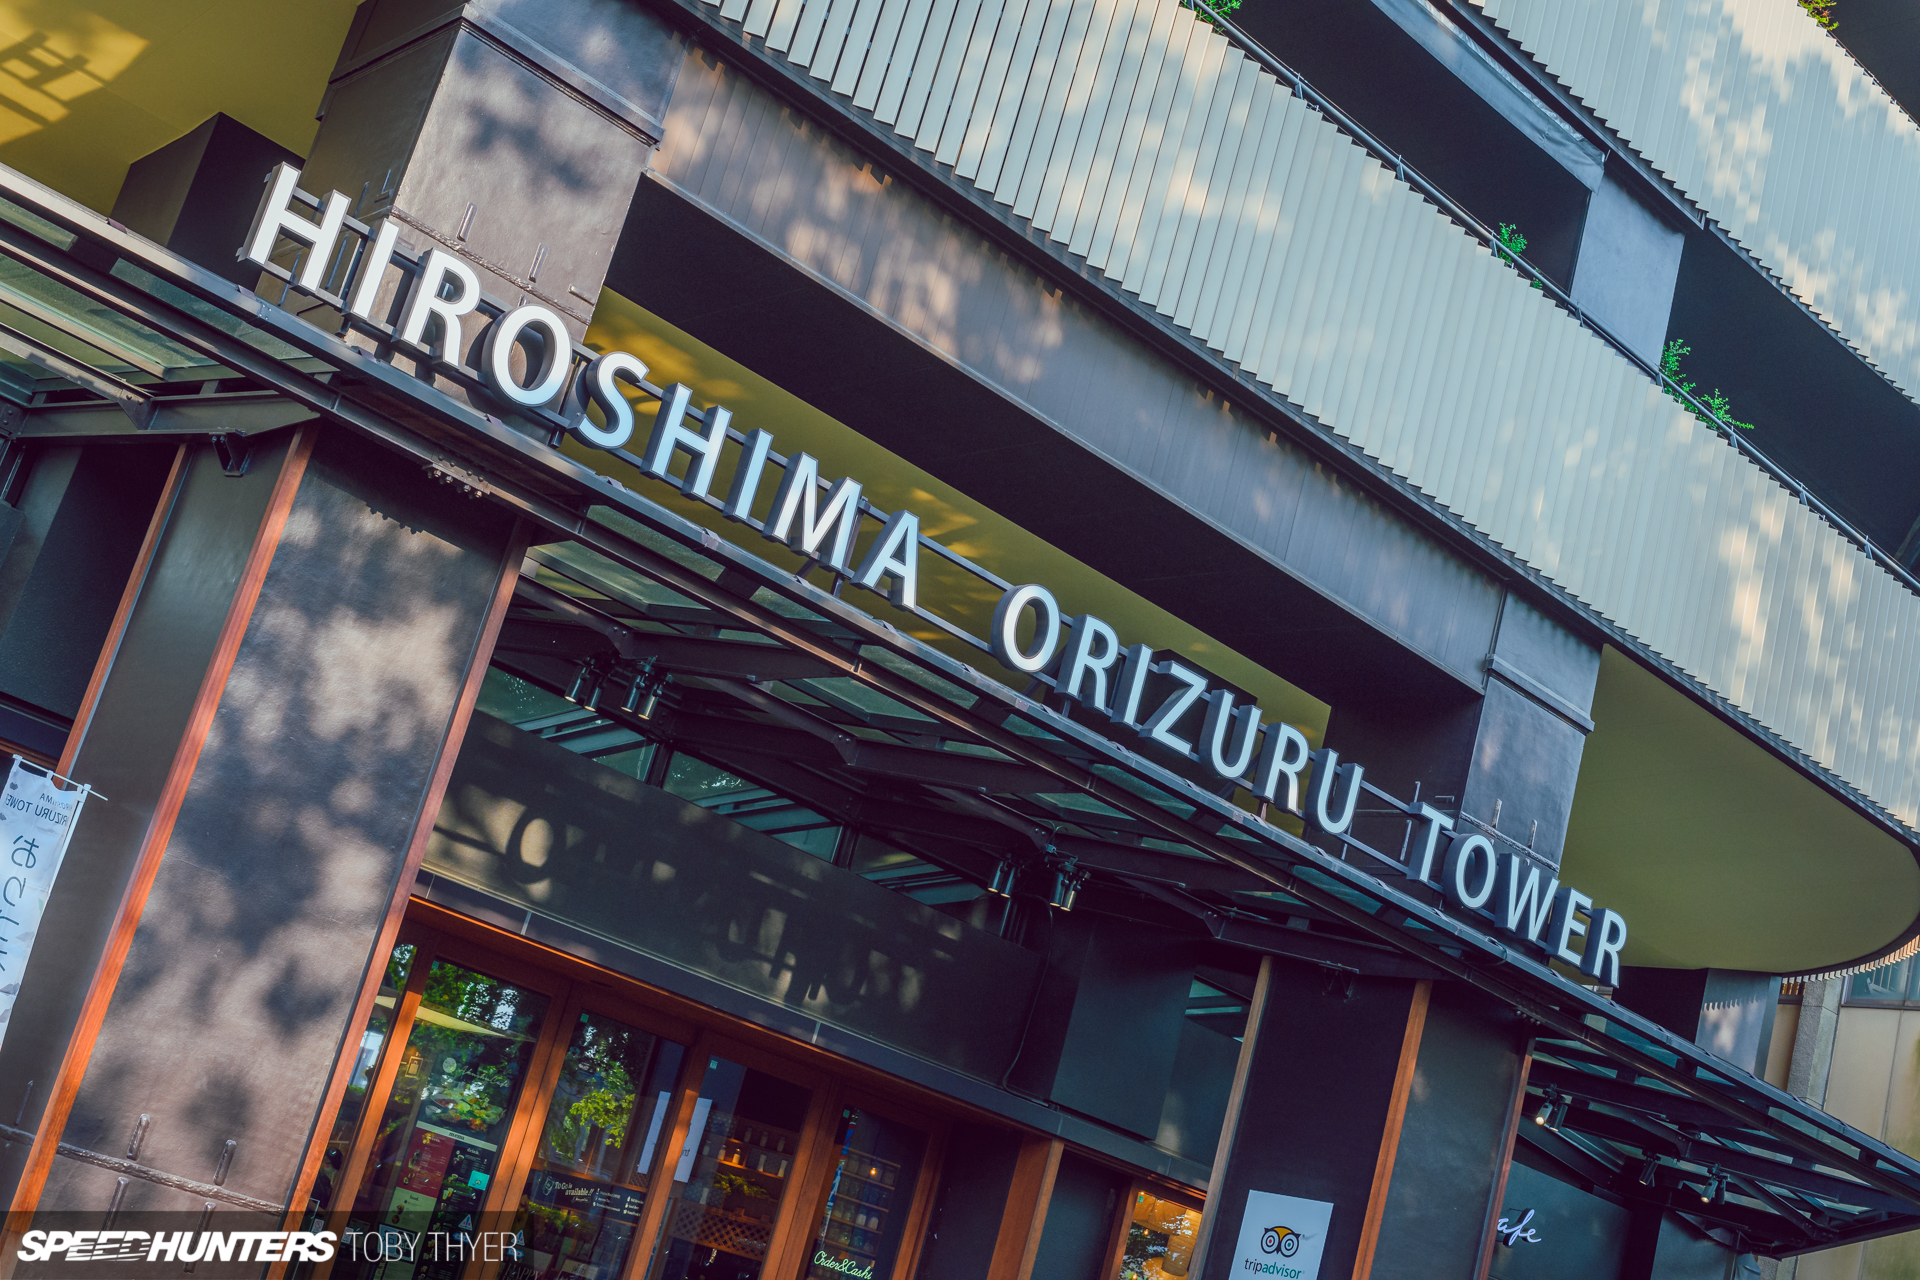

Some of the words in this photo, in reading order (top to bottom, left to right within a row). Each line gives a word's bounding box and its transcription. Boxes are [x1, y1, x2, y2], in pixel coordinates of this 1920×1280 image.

[247, 162, 920, 611] HIROSHIMA
[1001, 583, 1365, 835] ORIZURU
[1416, 802, 1628, 988] TOWER
[1497, 1209, 1541, 1246] afe
[1244, 1258, 1302, 1280] tripadvisor
